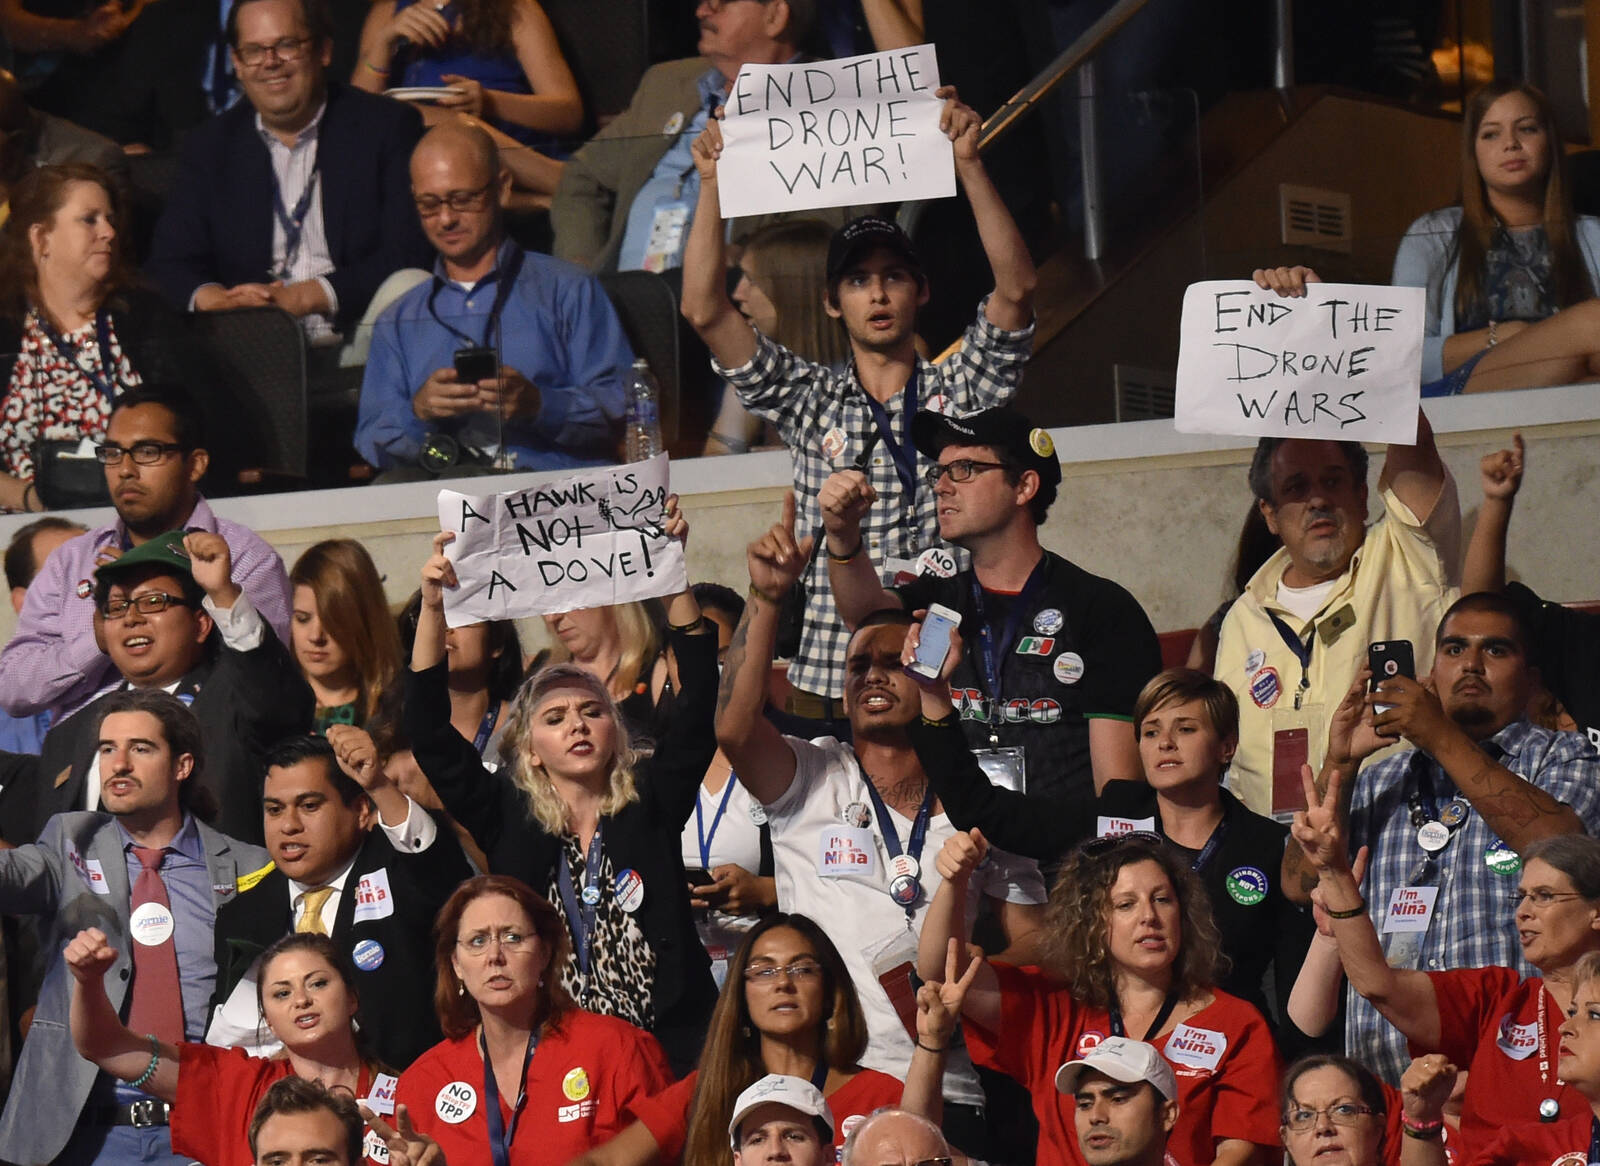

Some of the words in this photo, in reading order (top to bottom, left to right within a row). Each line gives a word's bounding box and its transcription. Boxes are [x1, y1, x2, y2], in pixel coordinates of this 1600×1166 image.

[737, 69, 836, 115] END
[842, 52, 929, 98] THE
[769, 101, 916, 151] DRONE
[769, 143, 908, 195] WAR!
[1214, 291, 1293, 333] END
[1318, 299, 1402, 340] THE
[1213, 343, 1376, 384] DRONE
[1236, 390, 1367, 430] WARS
[461, 499, 491, 533] A
[505, 482, 601, 520] HAWK
[488, 570, 518, 600] A
[537, 535, 655, 587] DOVE!
[931, 550, 954, 571] NO
[1111, 820, 1134, 831] I'm
[830, 837, 853, 849] I'm
[825, 850, 868, 866] Nina
[1238, 879, 1256, 892] NOT
[1399, 889, 1419, 901] I'm
[1391, 902, 1428, 917] Nina
[1184, 1029, 1208, 1041] I'm
[1172, 1037, 1217, 1056] Nina
[449, 1084, 472, 1101] NO
[439, 1101, 463, 1118] TPP
